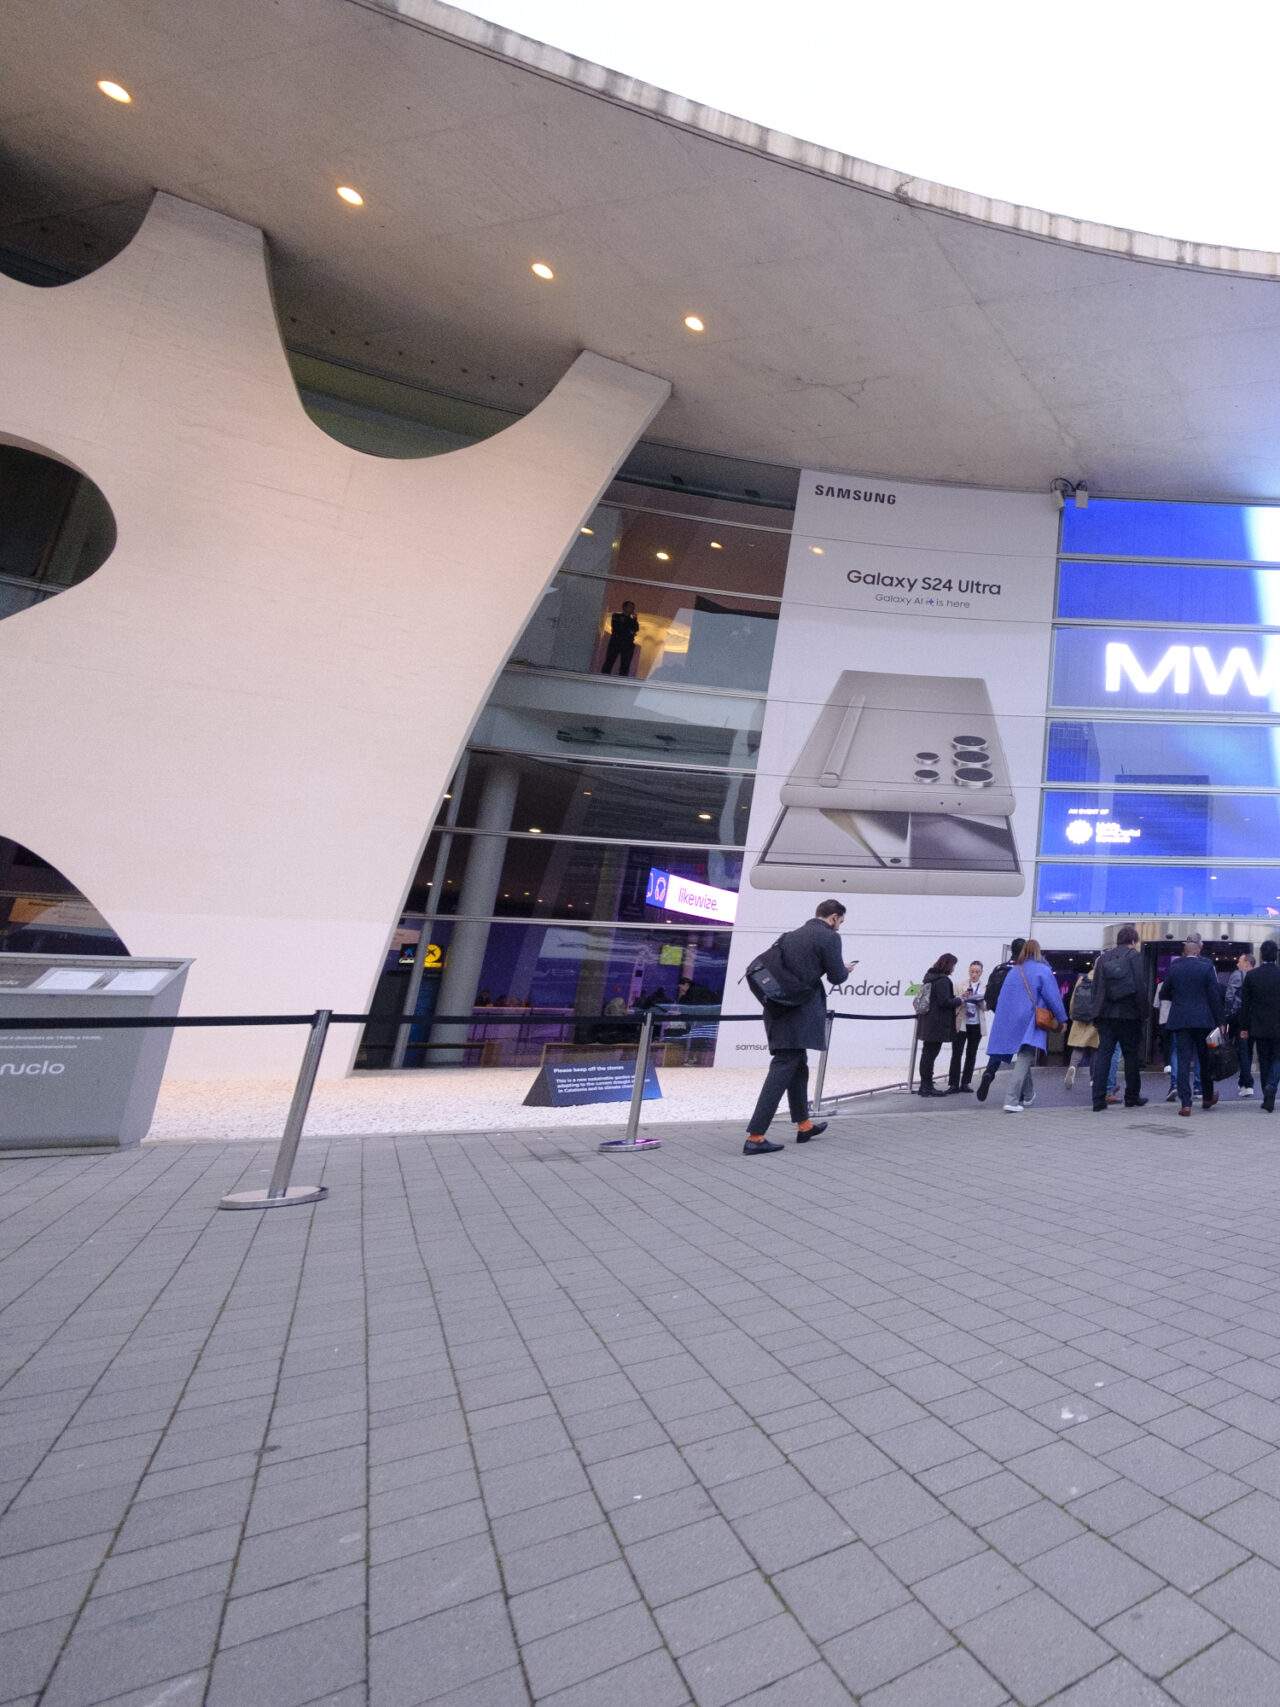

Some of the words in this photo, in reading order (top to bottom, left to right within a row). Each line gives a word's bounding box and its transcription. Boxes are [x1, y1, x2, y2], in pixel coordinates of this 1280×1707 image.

[814, 484, 897, 505] SAMSUNG
[846, 569, 918, 592] Galaxy
[920, 577, 953, 593] S24
[958, 580, 1002, 596] Ultra
[875, 593, 912, 607] Galaxy
[913, 597, 924, 605] AI
[936, 598, 944, 608] is
[946, 599, 971, 609] here
[828, 979, 901, 996] Android
